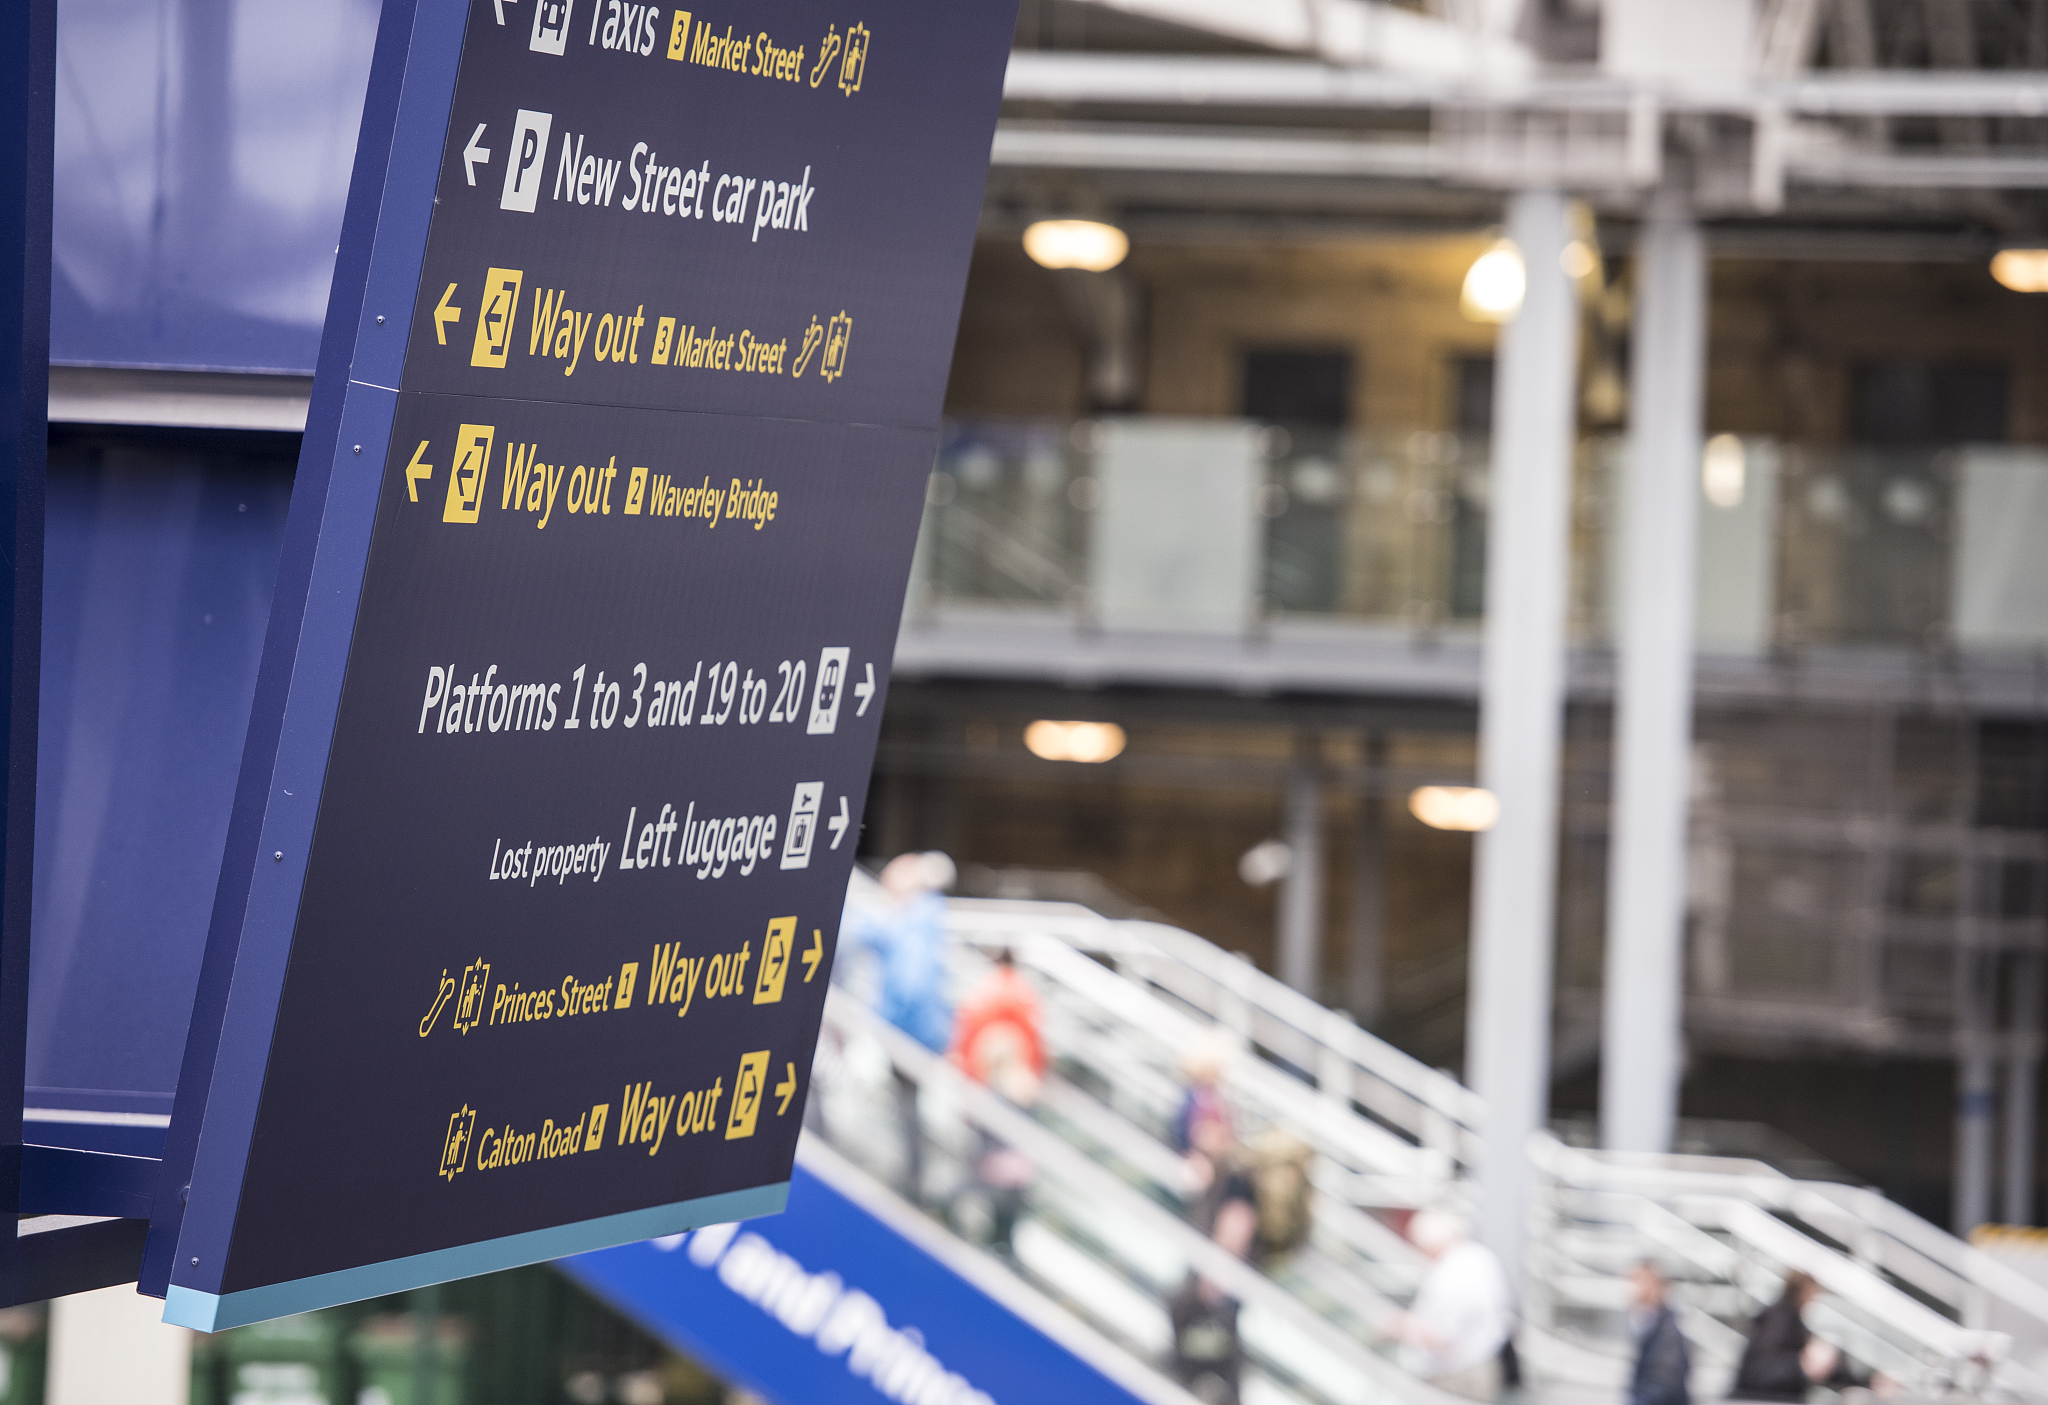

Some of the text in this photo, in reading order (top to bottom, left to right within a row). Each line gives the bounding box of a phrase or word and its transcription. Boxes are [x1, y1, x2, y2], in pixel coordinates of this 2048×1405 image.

[690, 21, 751, 73] Market
[751, 32, 804, 82] Street
[513, 128, 815, 242] P New Street car park
[530, 288, 592, 376] Way
[595, 305, 644, 364] out
[674, 325, 734, 370] Market
[734, 329, 787, 374] Street
[502, 443, 564, 529] Way
[568, 456, 617, 515] out
[650, 475, 726, 528] Waverley
[726, 478, 778, 530] Bridge
[418, 660, 806, 734] Platforms 1 to 3 and 19 to 20
[490, 801, 777, 887] Lost property Left luggage
[490, 982, 555, 1025] Princes
[557, 975, 612, 1017] Street
[648, 942, 704, 1017] Way
[705, 941, 750, 998] out
[478, 1125, 535, 1170] Calton
[537, 1112, 585, 1159] Road
[618, 1081, 675, 1156] Way
[677, 1077, 722, 1136] out
